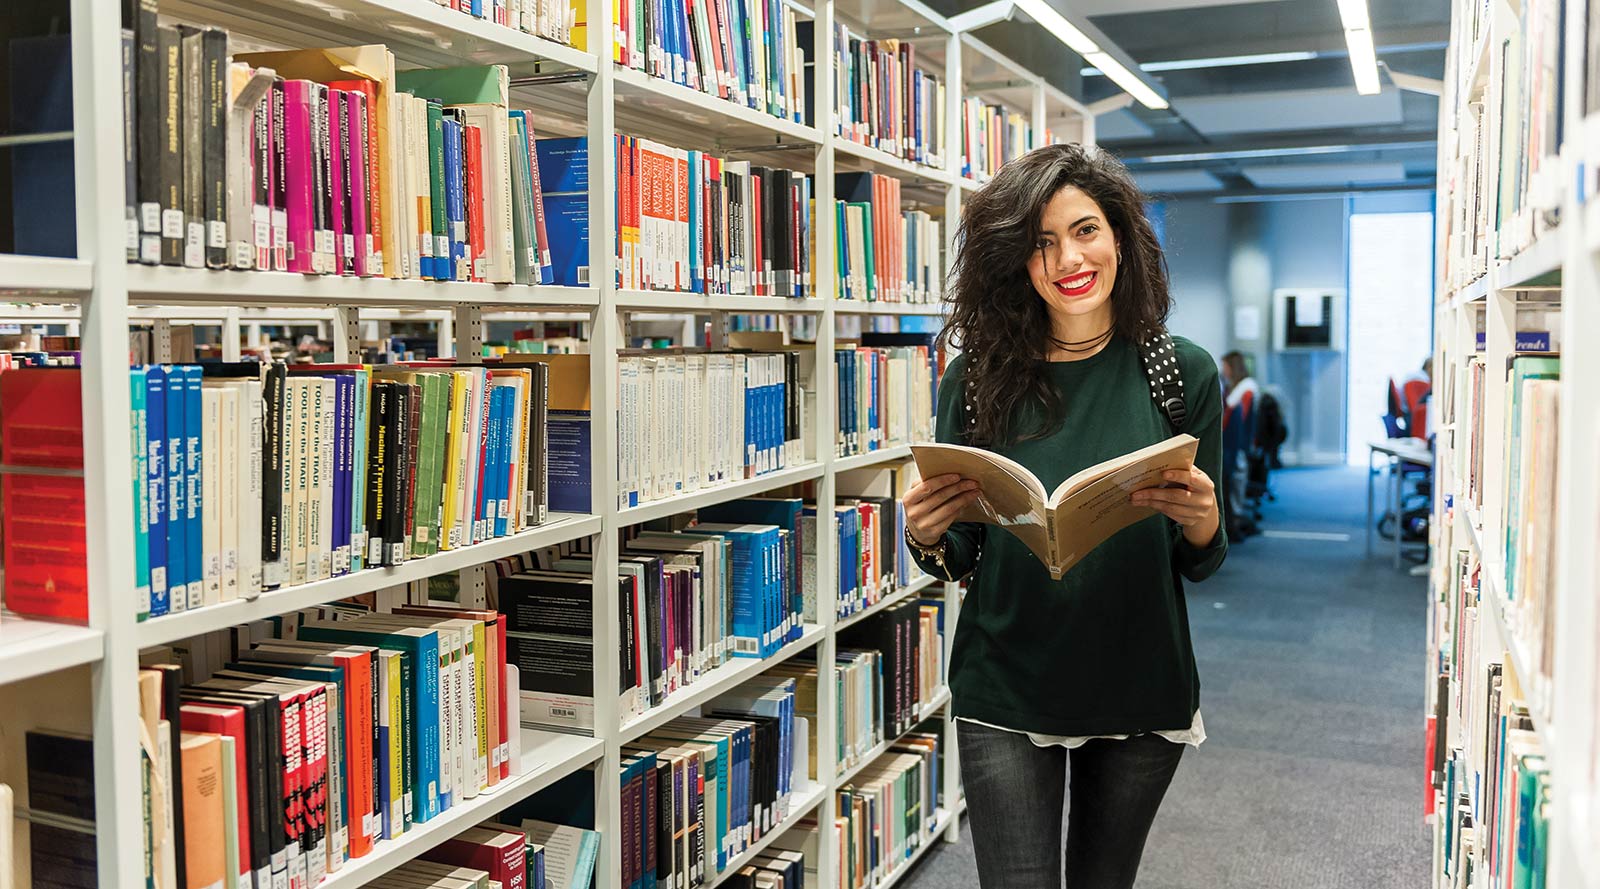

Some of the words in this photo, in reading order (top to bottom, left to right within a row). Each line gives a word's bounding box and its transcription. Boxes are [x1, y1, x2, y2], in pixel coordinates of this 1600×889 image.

[168, 46, 178, 66] The
[168, 67, 178, 92] True
[166, 92, 178, 153] Interpreter
[529, 131, 540, 187] TRANSLATION
[534, 188, 544, 222] STUDIES
[1516, 338, 1546, 350] rends
[149, 440, 161, 475] Machine
[170, 438, 180, 472] Machine
[188, 437, 198, 470] Machine
[378, 425, 386, 463] Machine
[149, 478, 162, 524] Translation
[170, 474, 182, 522] Translation
[188, 473, 200, 519] Translation
[376, 465, 384, 520] Translation
[305, 699, 314, 765] BAKHTIN
[510, 872, 523, 887] HSK
